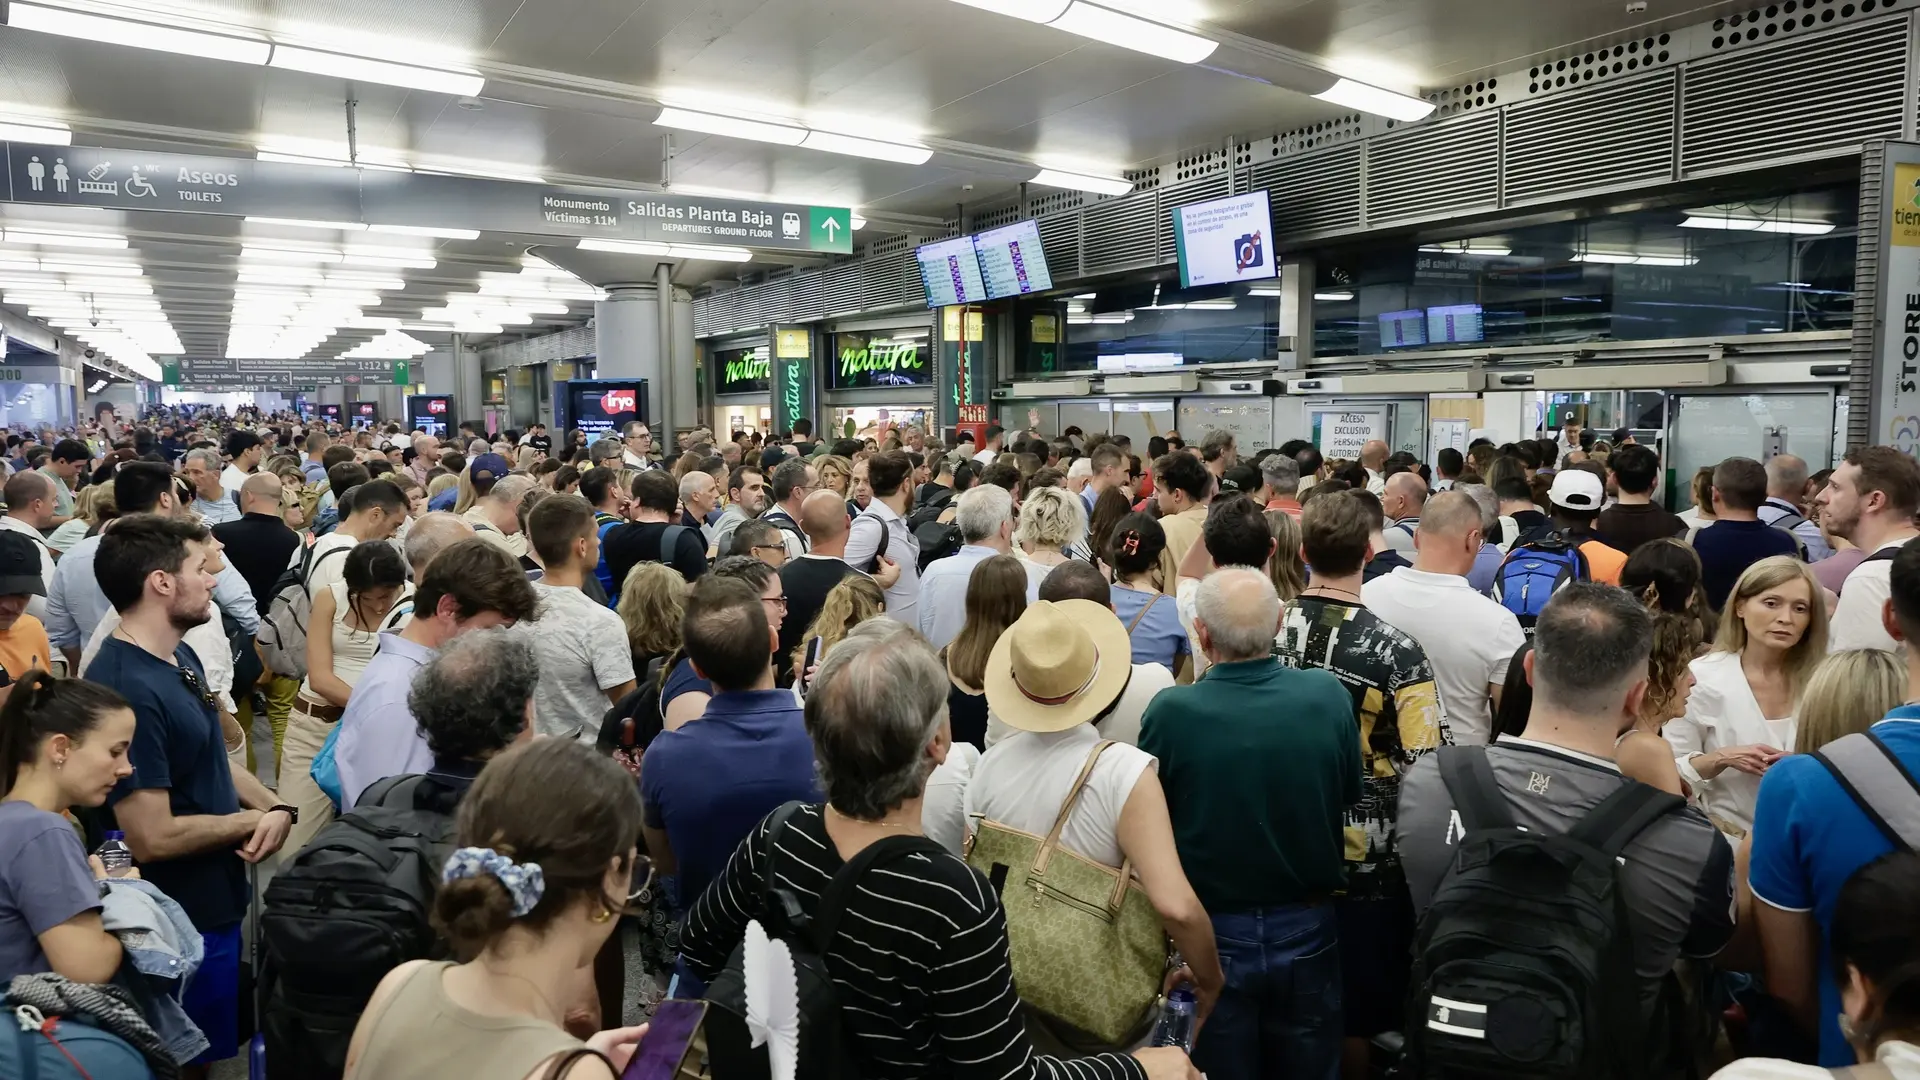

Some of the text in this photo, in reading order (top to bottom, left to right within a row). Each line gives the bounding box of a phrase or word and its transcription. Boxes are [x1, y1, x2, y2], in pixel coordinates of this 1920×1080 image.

[145, 164, 160, 173] WC
[176, 166, 239, 188] Aseos
[178, 189, 222, 204] TOILETS
[543, 196, 610, 212] Monumento
[544, 210, 617, 226] Víctimas 11M
[628, 201, 773, 228] Salidas Planta Baja
[662, 222, 773, 239] DEPARTURES GROUND FLOOR
[840, 338, 924, 377] natura
[431, 401, 446, 412] iryo
[608, 393, 634, 410] iryo
[1340, 414, 1365, 424] ACCESO
[1334, 426, 1371, 435] EXCLUSIVO
[1328, 448, 1362, 458] AUTORIZA
[1344, 670, 1379, 687] LANGUAGE
